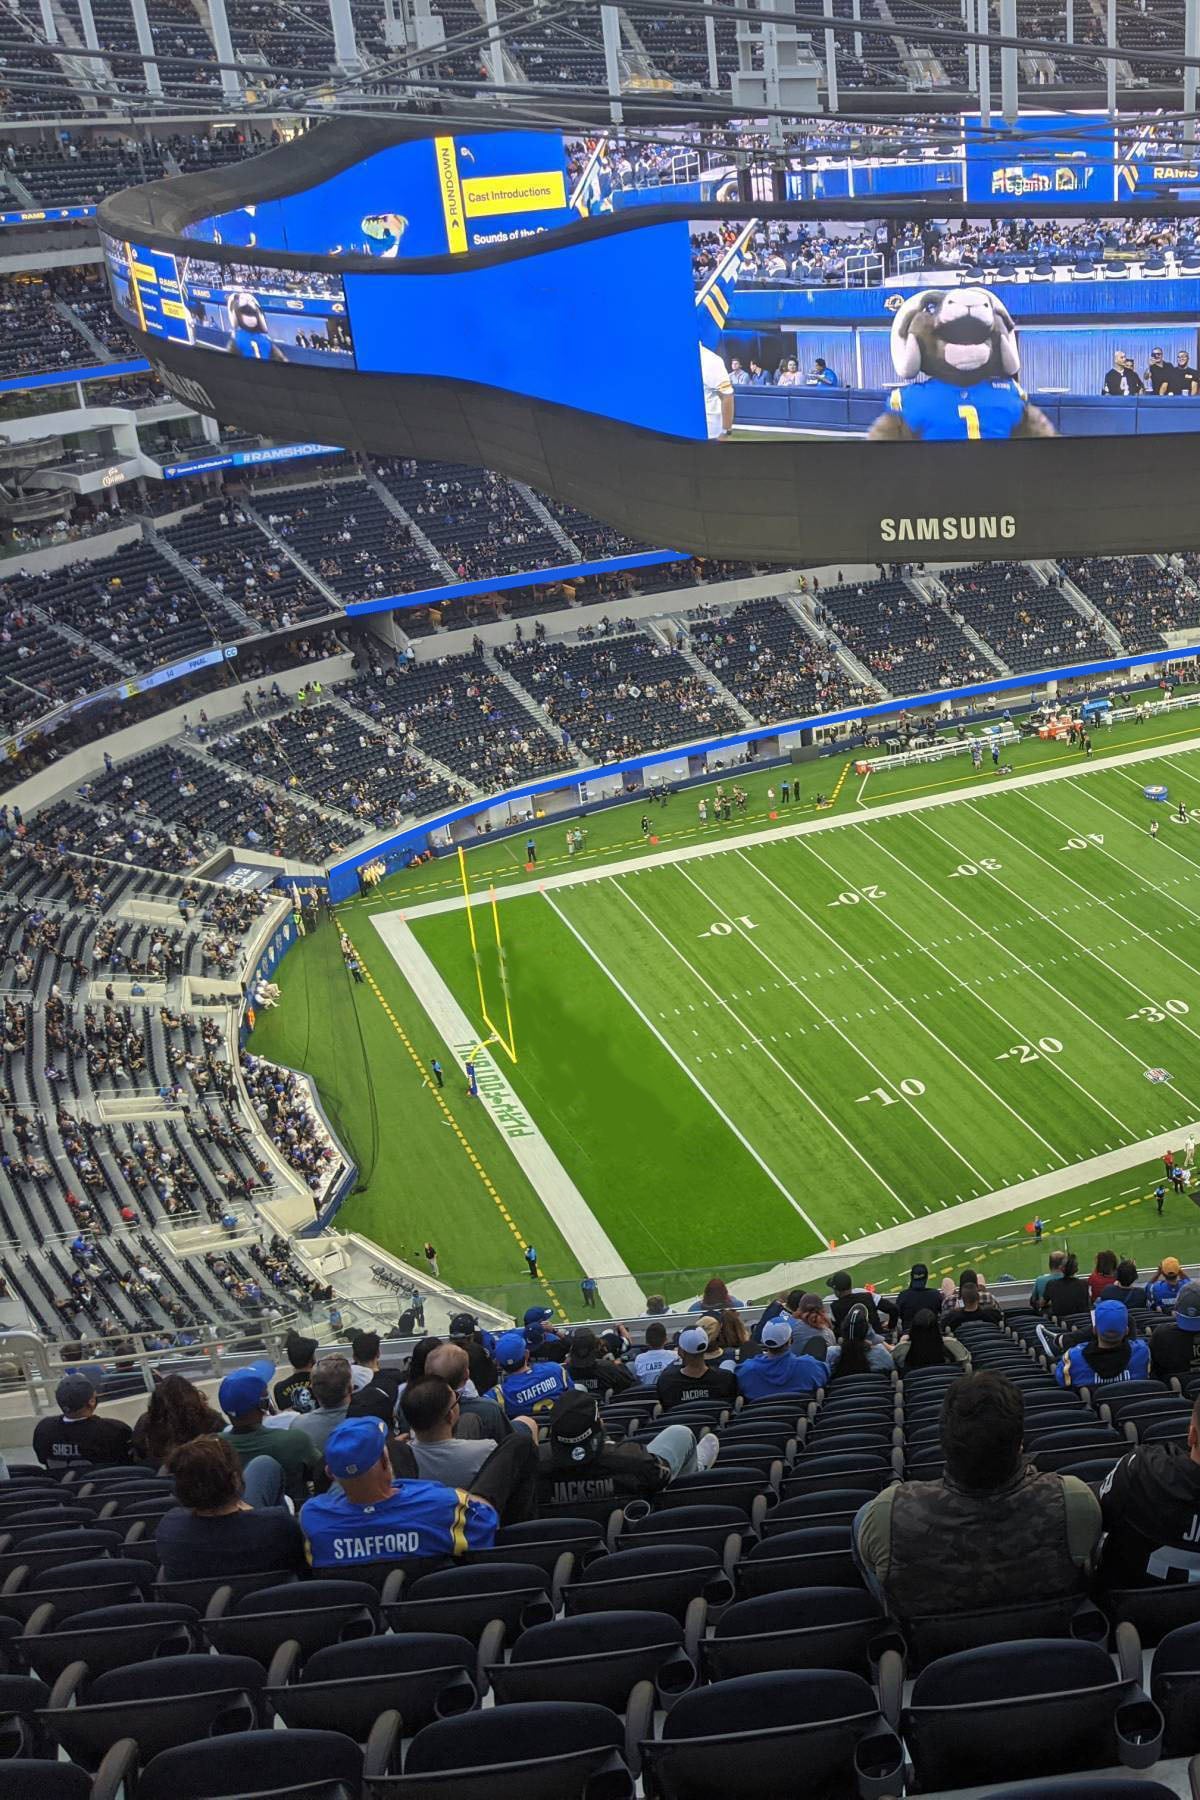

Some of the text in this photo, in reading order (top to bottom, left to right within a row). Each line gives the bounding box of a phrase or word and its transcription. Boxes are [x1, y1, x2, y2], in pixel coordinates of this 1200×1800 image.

[442, 148, 457, 215] RUNDOWN
[1153, 167, 1198, 179] RAMS
[468, 187, 552, 203] Cast Introductions
[473, 232, 508, 245] Sounds
[509, 229, 519, 239] of
[957, 404, 981, 440] 1
[880, 516, 1016, 542] SAMSUNG
[1067, 833, 1104, 851] 40
[958, 858, 1003, 877] 30
[838, 884, 888, 905] 20
[710, 914, 760, 937] 10
[1139, 999, 1190, 1023] 30
[1009, 1037, 1064, 1064] 20
[870, 1078, 926, 1107] 10
[491, 1103, 535, 1138] PLAY
[516, 1376, 557, 1403] STAFFORD
[680, 1389, 709, 1401] JACOBS
[52, 1443, 81, 1456] SHELL
[552, 1478, 614, 1502] JACKSON
[333, 1532, 420, 1560] STAFFORD
